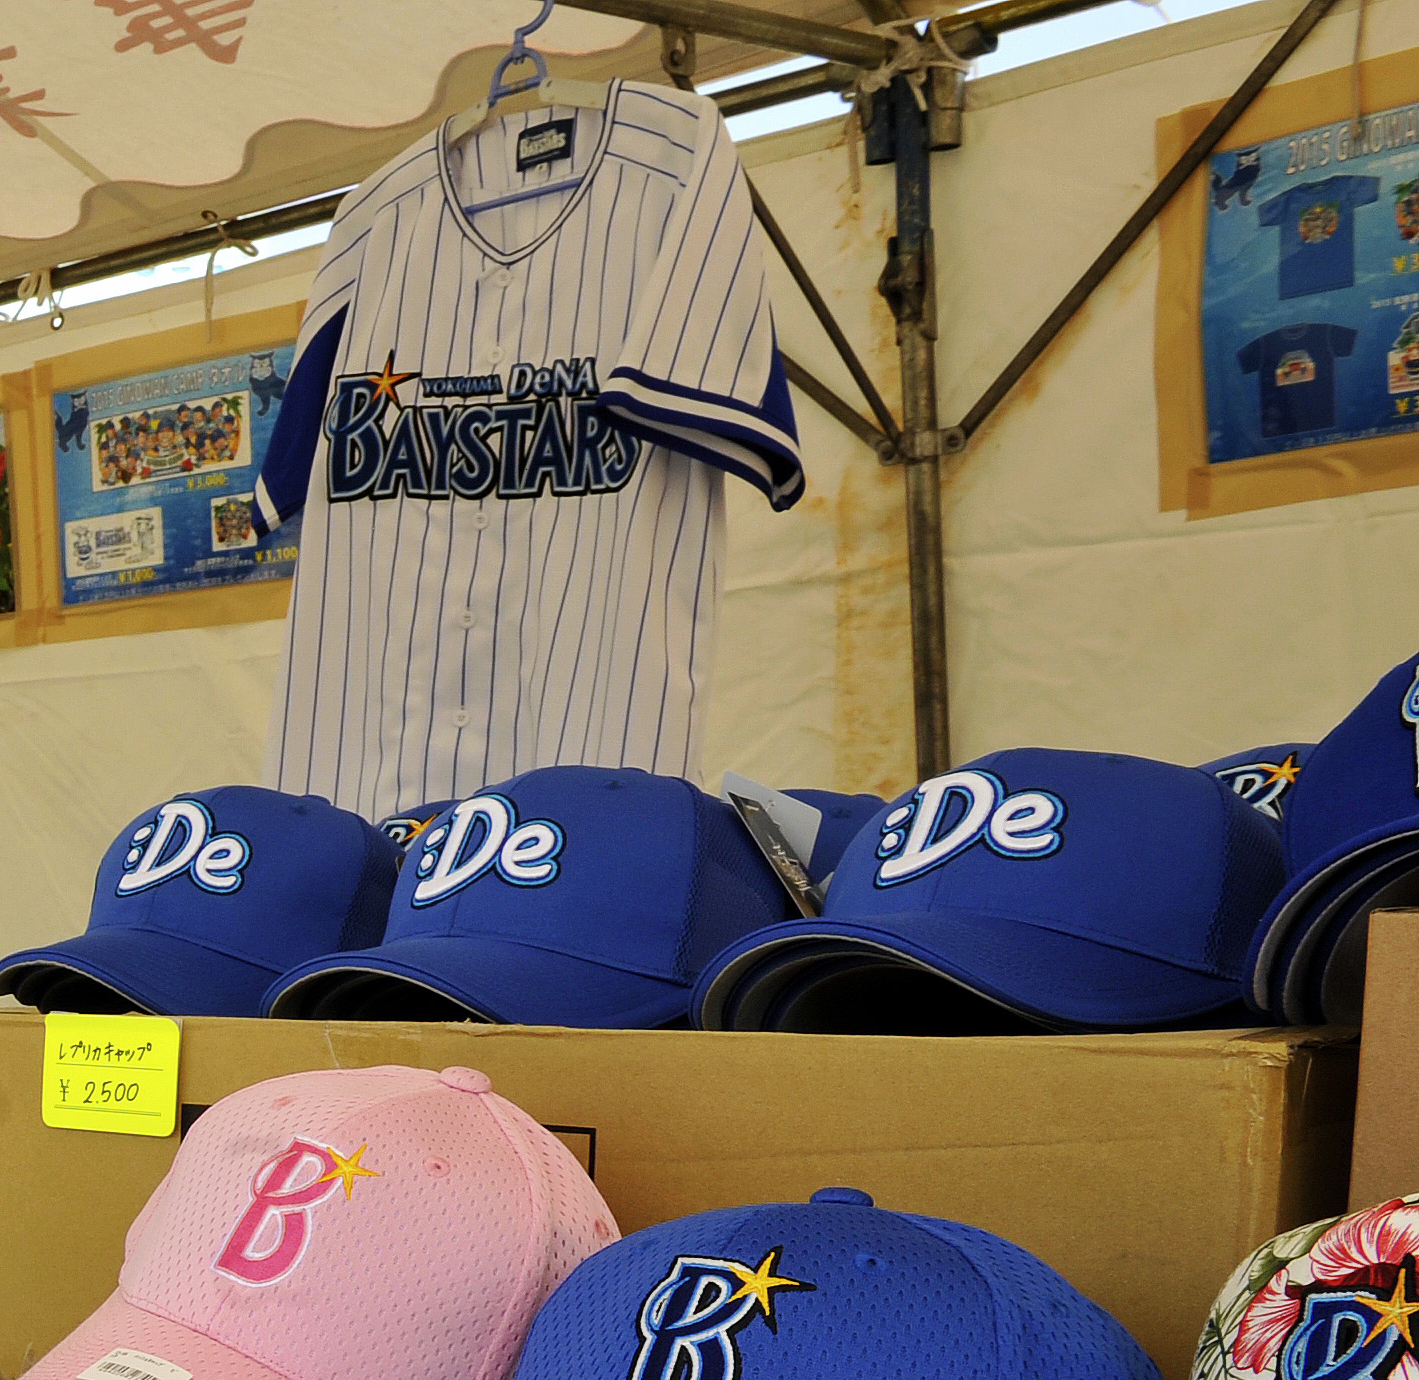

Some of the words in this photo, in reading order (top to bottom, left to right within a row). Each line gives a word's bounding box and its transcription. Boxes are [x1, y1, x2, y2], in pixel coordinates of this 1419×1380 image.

[421, 374, 502, 399] YOKOHAMA
[509, 357, 600, 400] DeNA
[325, 370, 642, 503] BAYSTARS
[58, 1040, 153, 1064] レプリカキャップ
[210, 1136, 344, 1287] B
